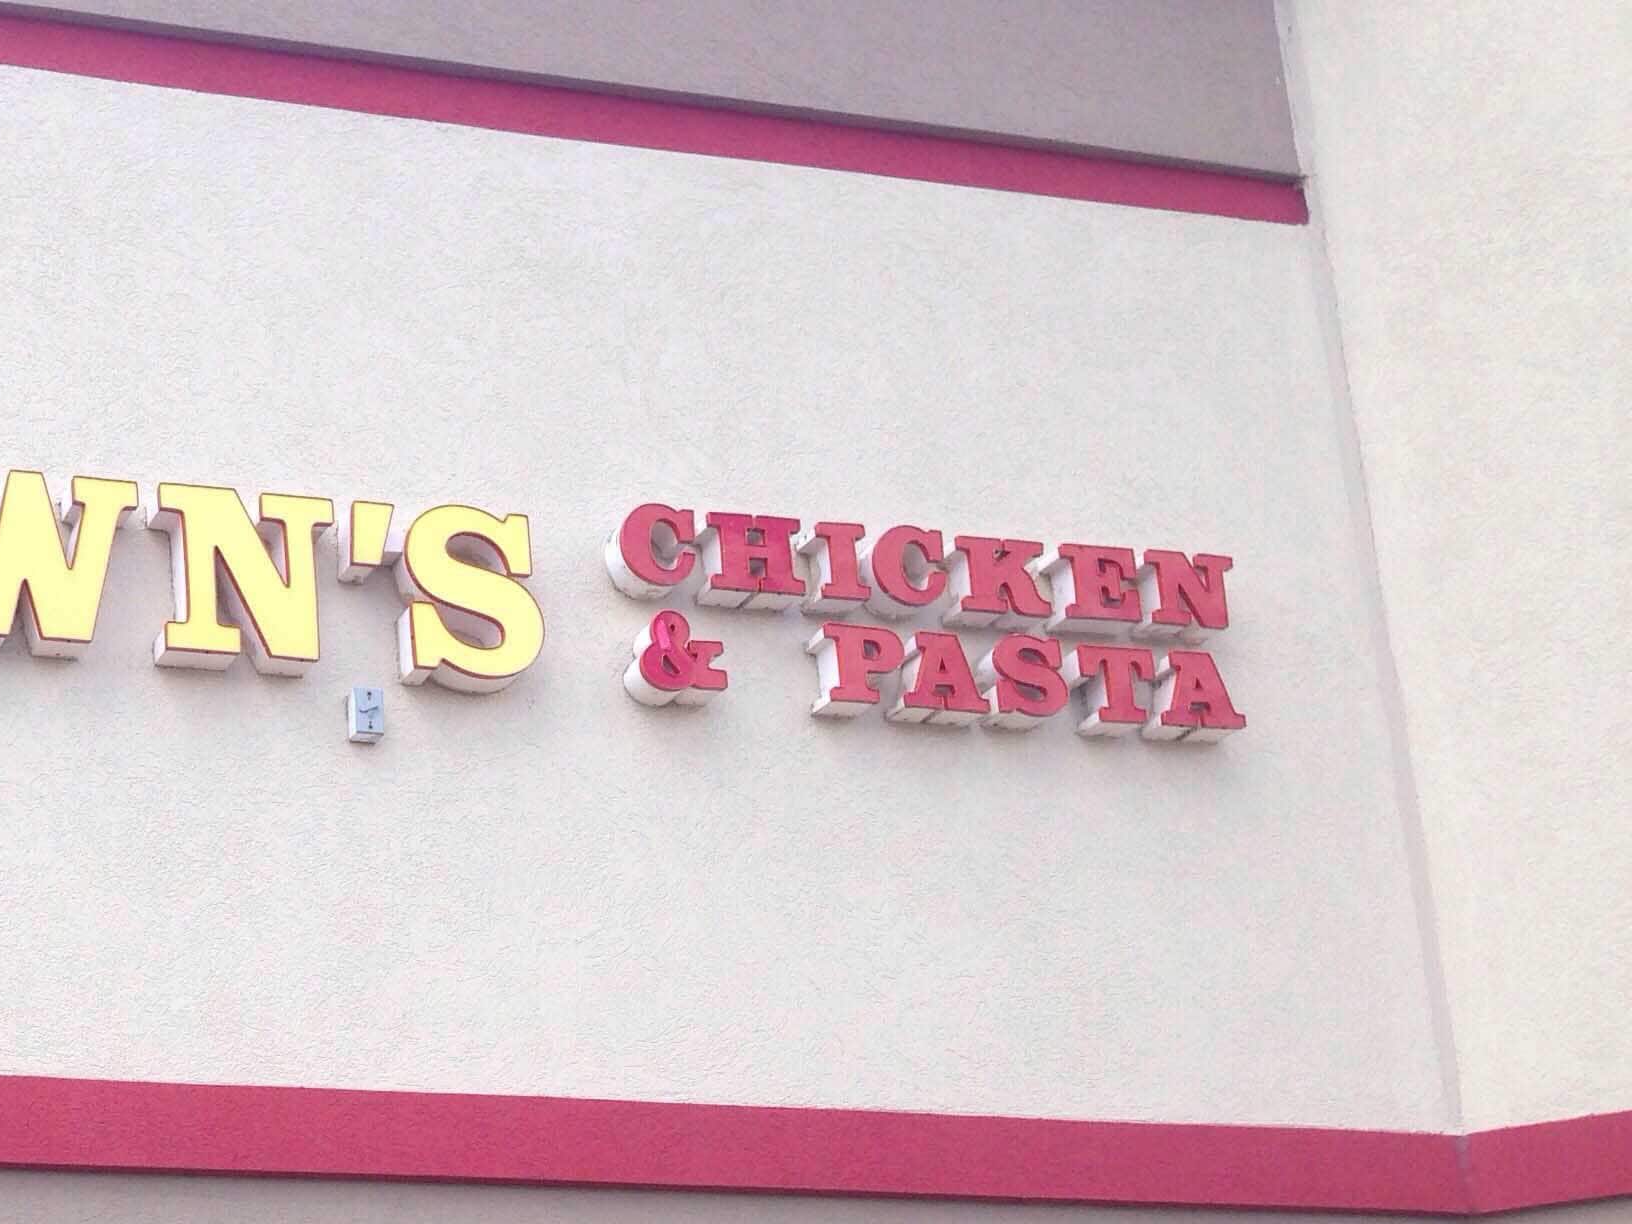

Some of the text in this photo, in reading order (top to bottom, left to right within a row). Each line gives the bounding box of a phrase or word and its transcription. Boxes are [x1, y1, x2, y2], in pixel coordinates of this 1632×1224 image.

[616, 502, 1234, 630] CHICKEN
[639, 609, 1247, 729] & PASTA
